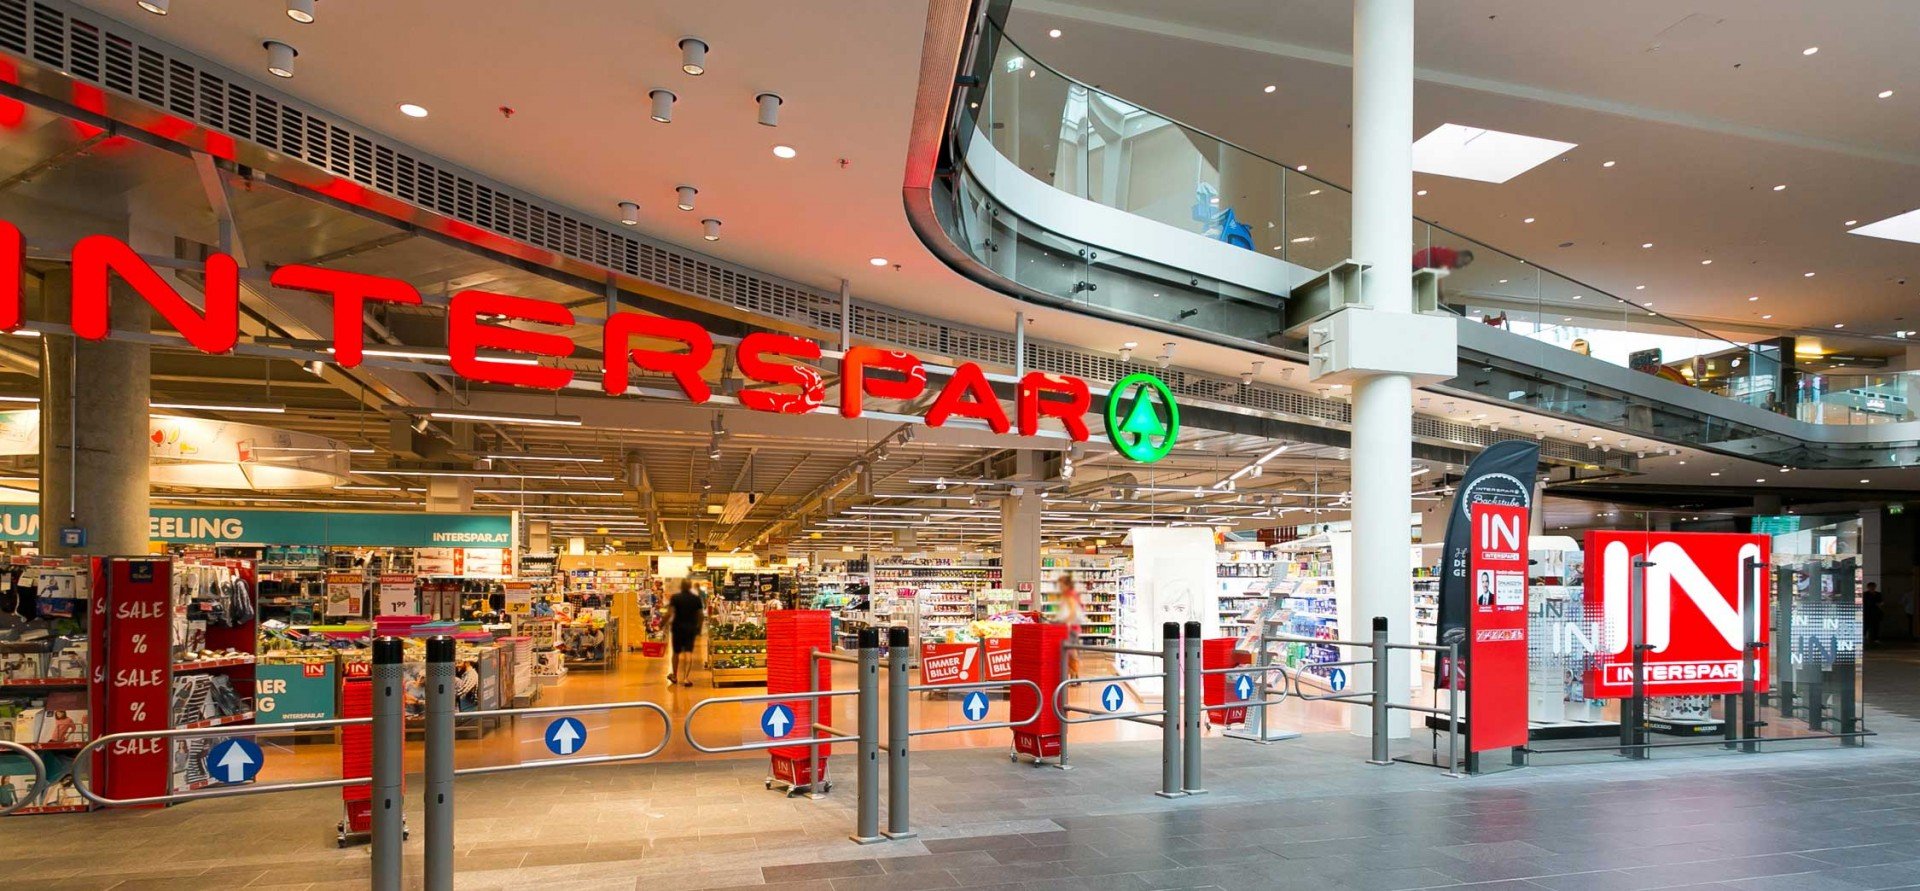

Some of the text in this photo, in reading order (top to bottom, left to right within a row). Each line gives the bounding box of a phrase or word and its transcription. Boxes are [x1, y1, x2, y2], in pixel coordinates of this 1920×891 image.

[0, 219, 1091, 442] INTERSPAR
[433, 532, 509, 542] INTERSPAR.AT
[1482, 513, 1520, 551] IN
[329, 575, 361, 583] AKTION
[1604, 540, 1761, 654] IN
[116, 601, 165, 619] SALE
[131, 634, 148, 654] %
[1553, 621, 1599, 654] IN
[306, 664, 324, 673] IN
[351, 664, 369, 673] IN
[929, 657, 960, 669] IMMER
[114, 669, 163, 688] SALE
[930, 667, 959, 678] BILLIG
[1617, 664, 1738, 682] INTERSPAR
[130, 702, 147, 722] %
[282, 712, 325, 720] INTERSPAR.AT
[113, 737, 163, 755] SALE
[1020, 736, 1032, 746] IN
[777, 760, 789, 771] IN
